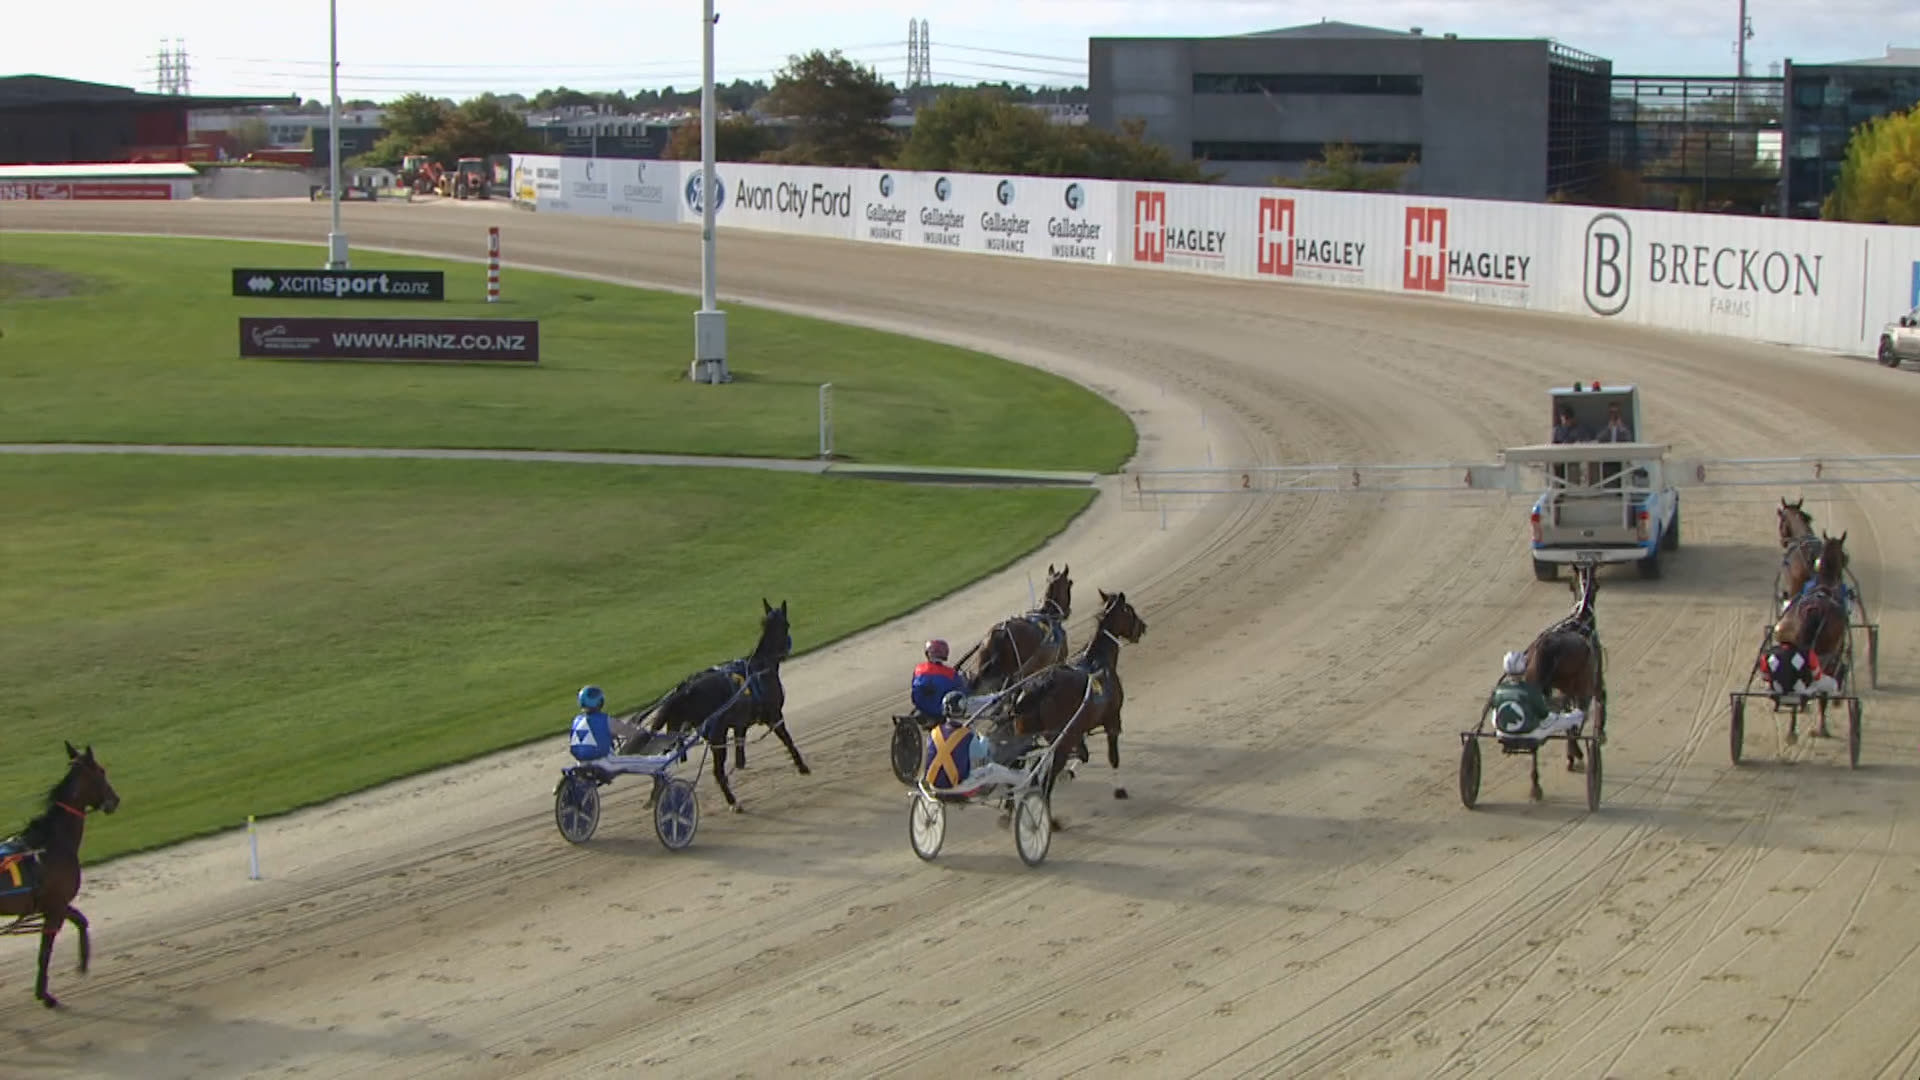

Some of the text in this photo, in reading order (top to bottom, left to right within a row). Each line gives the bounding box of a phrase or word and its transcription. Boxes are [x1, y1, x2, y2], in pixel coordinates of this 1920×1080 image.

[735, 178, 773, 211] Avon
[777, 181, 808, 218] City
[812, 183, 851, 218] Ford
[865, 202, 907, 226] Gallagher
[920, 206, 965, 231] Gallagher
[980, 210, 1031, 236] Gallagher
[924, 231, 961, 247] INSURANCE
[1047, 216, 1102, 244] Gallagher
[1166, 227, 1226, 253] HAGLEY
[985, 237, 1025, 254] INSURANCE
[1051, 244, 1097, 261] INSURANCE
[1295, 238, 1366, 267] HAGLEY
[1449, 250, 1531, 282] HAGLEY
[1649, 242, 1823, 297] BRECKON
[279, 273, 429, 297] xcmsport.co.nz
[1709, 297, 1751, 319] FARMS
[333, 332, 526, 351] WWW.HRNZ.CO.NZ
